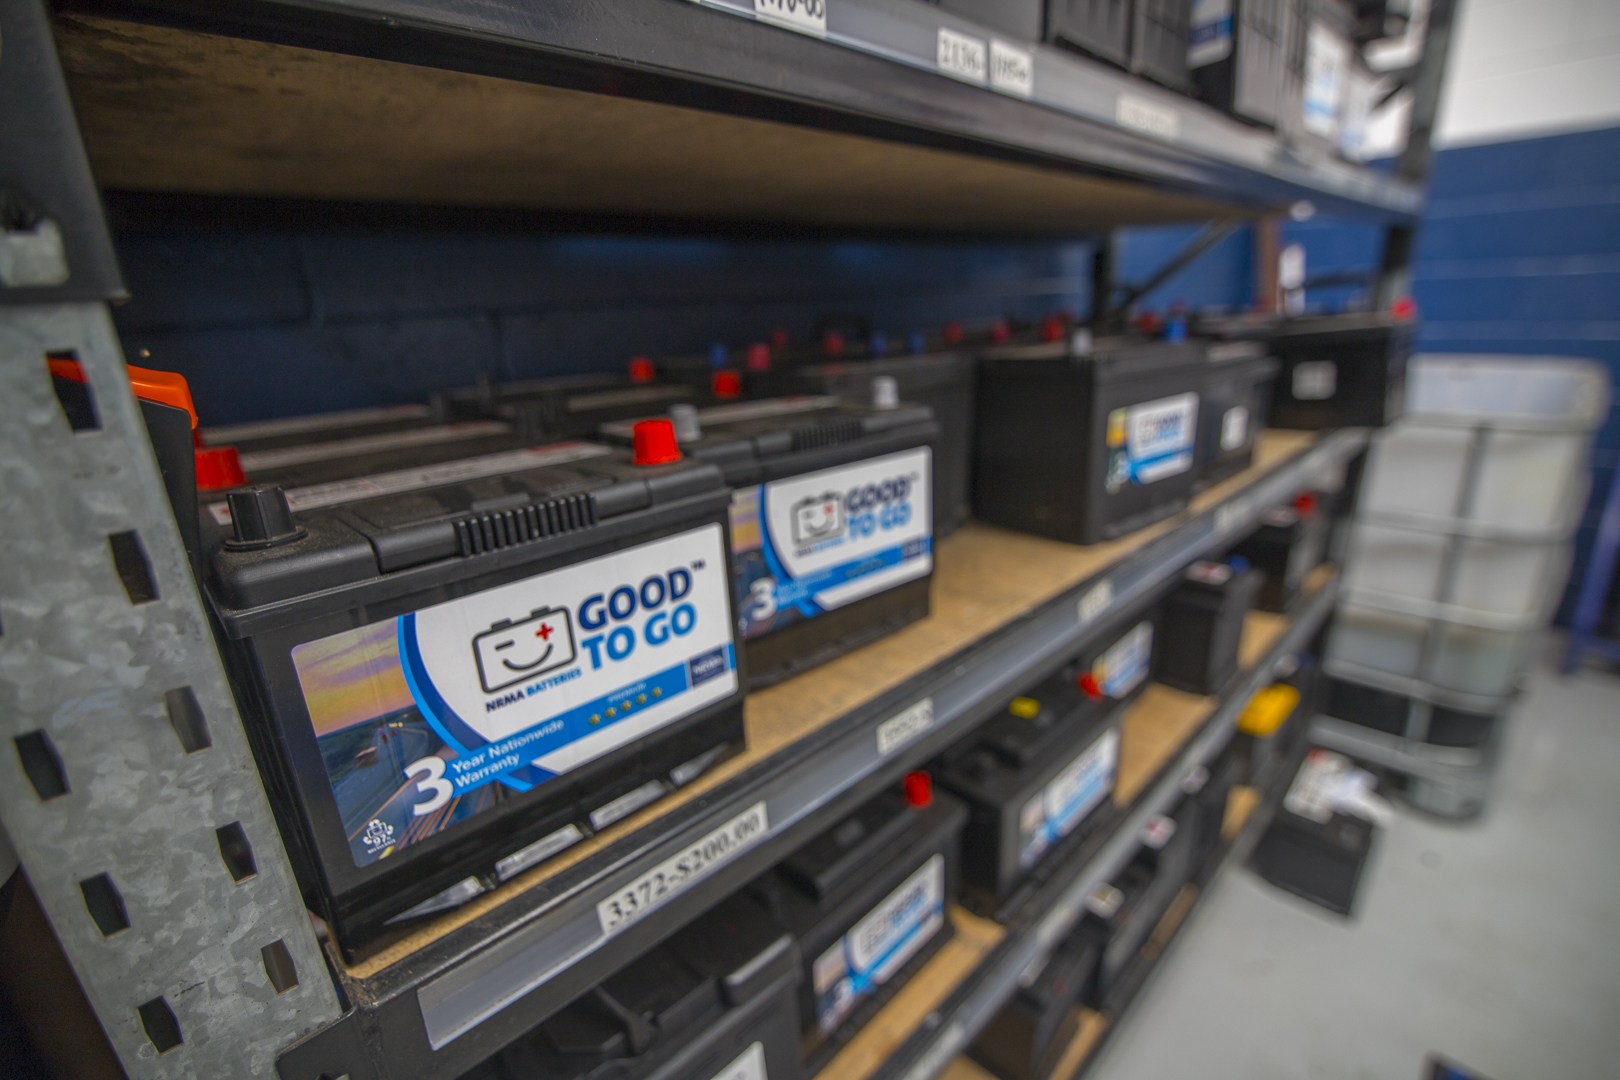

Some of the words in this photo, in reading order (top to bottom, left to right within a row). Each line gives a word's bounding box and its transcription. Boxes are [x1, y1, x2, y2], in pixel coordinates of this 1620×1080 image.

[750, 577, 778, 621] 3
[580, 624, 637, 671] TO
[643, 601, 697, 647] GO
[485, 689, 526, 713] NRMA
[526, 666, 583, 697] BATTERIES
[452, 751, 486, 774] Year
[488, 719, 565, 759] Nationwide
[455, 753, 520, 789] Warranty
[403, 755, 455, 816] 3
[605, 810, 761, 927] 3372-$200.00
